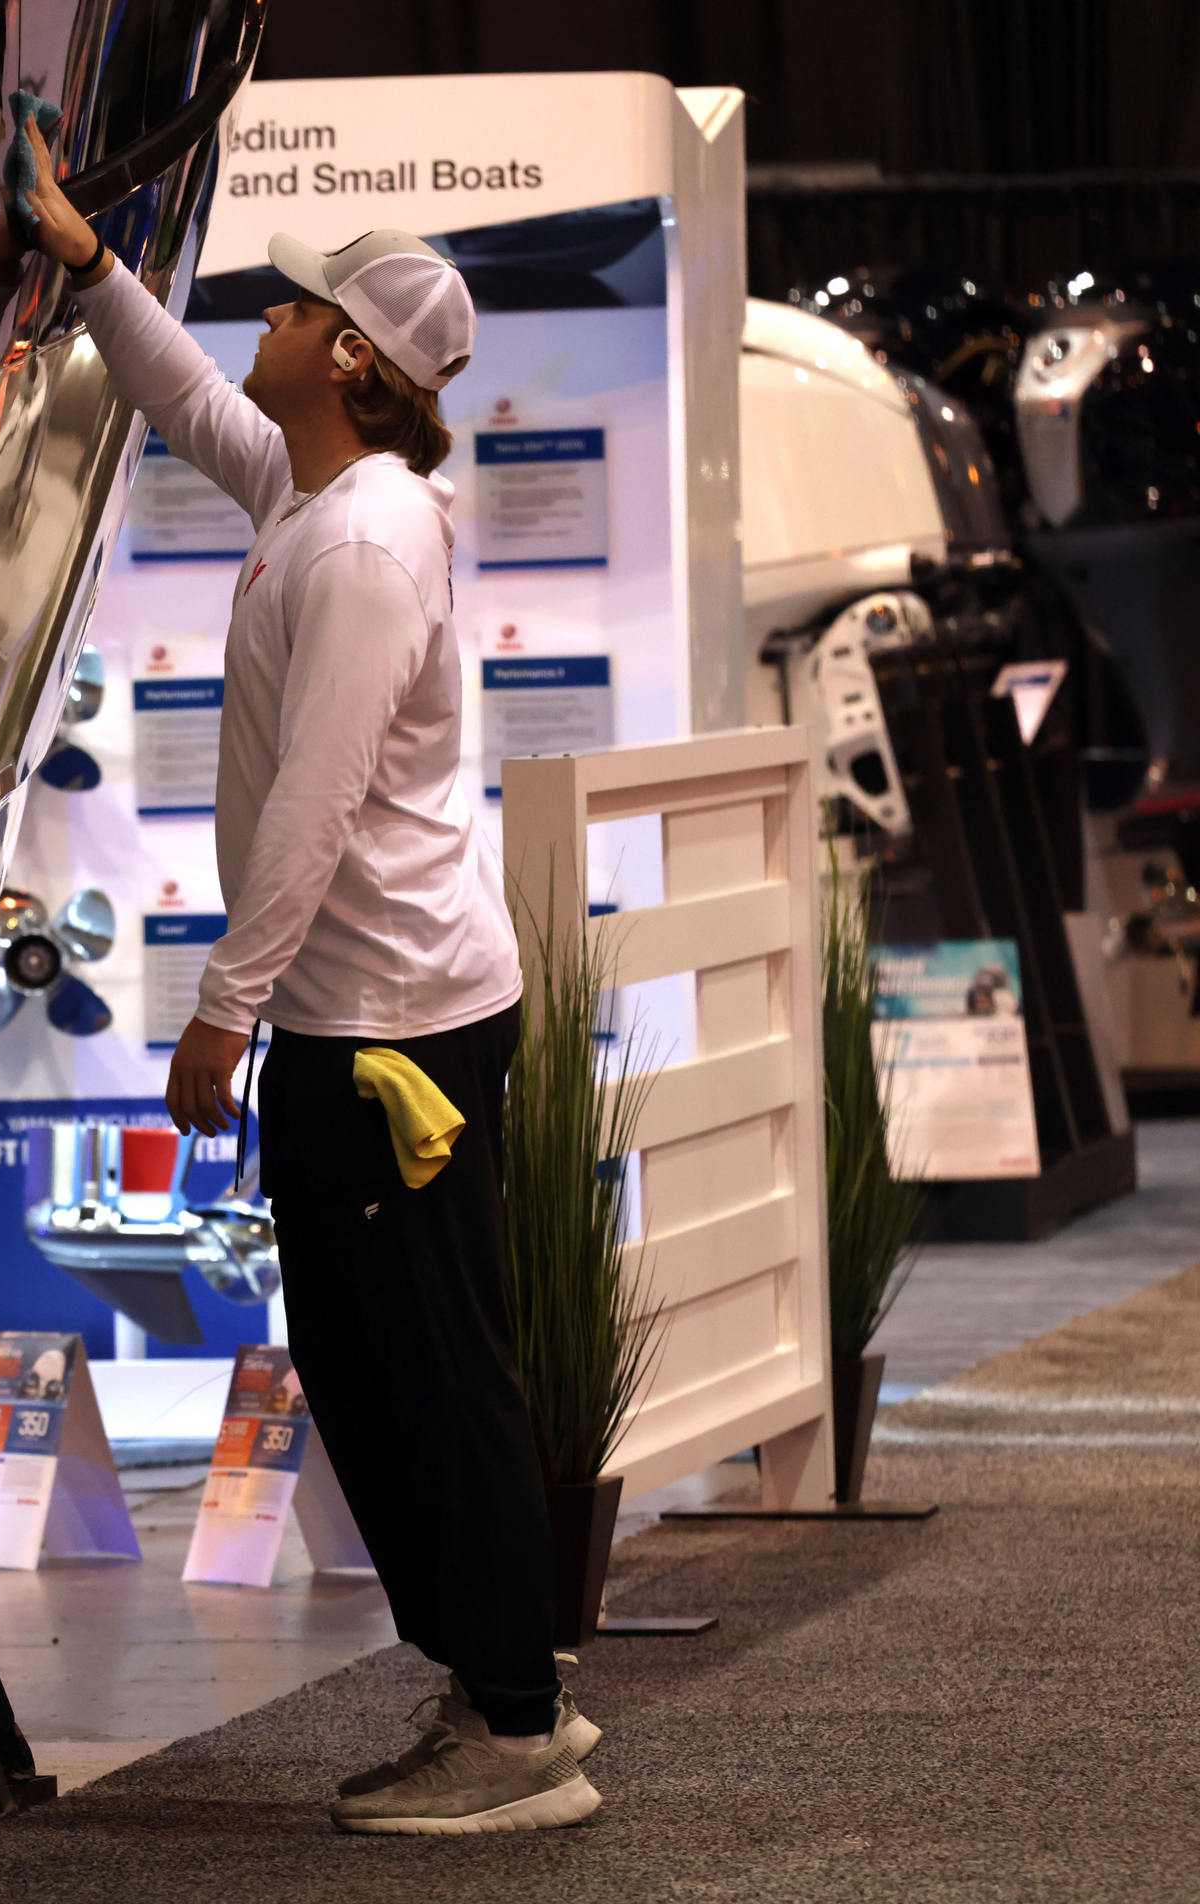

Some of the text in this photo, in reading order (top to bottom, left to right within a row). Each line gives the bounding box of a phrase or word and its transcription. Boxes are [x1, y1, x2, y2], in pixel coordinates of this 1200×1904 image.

[230, 119, 336, 152] edium
[229, 159, 543, 198] and Small Boats
[17, 1411, 50, 1437] 350
[262, 1425, 294, 1452] 350
